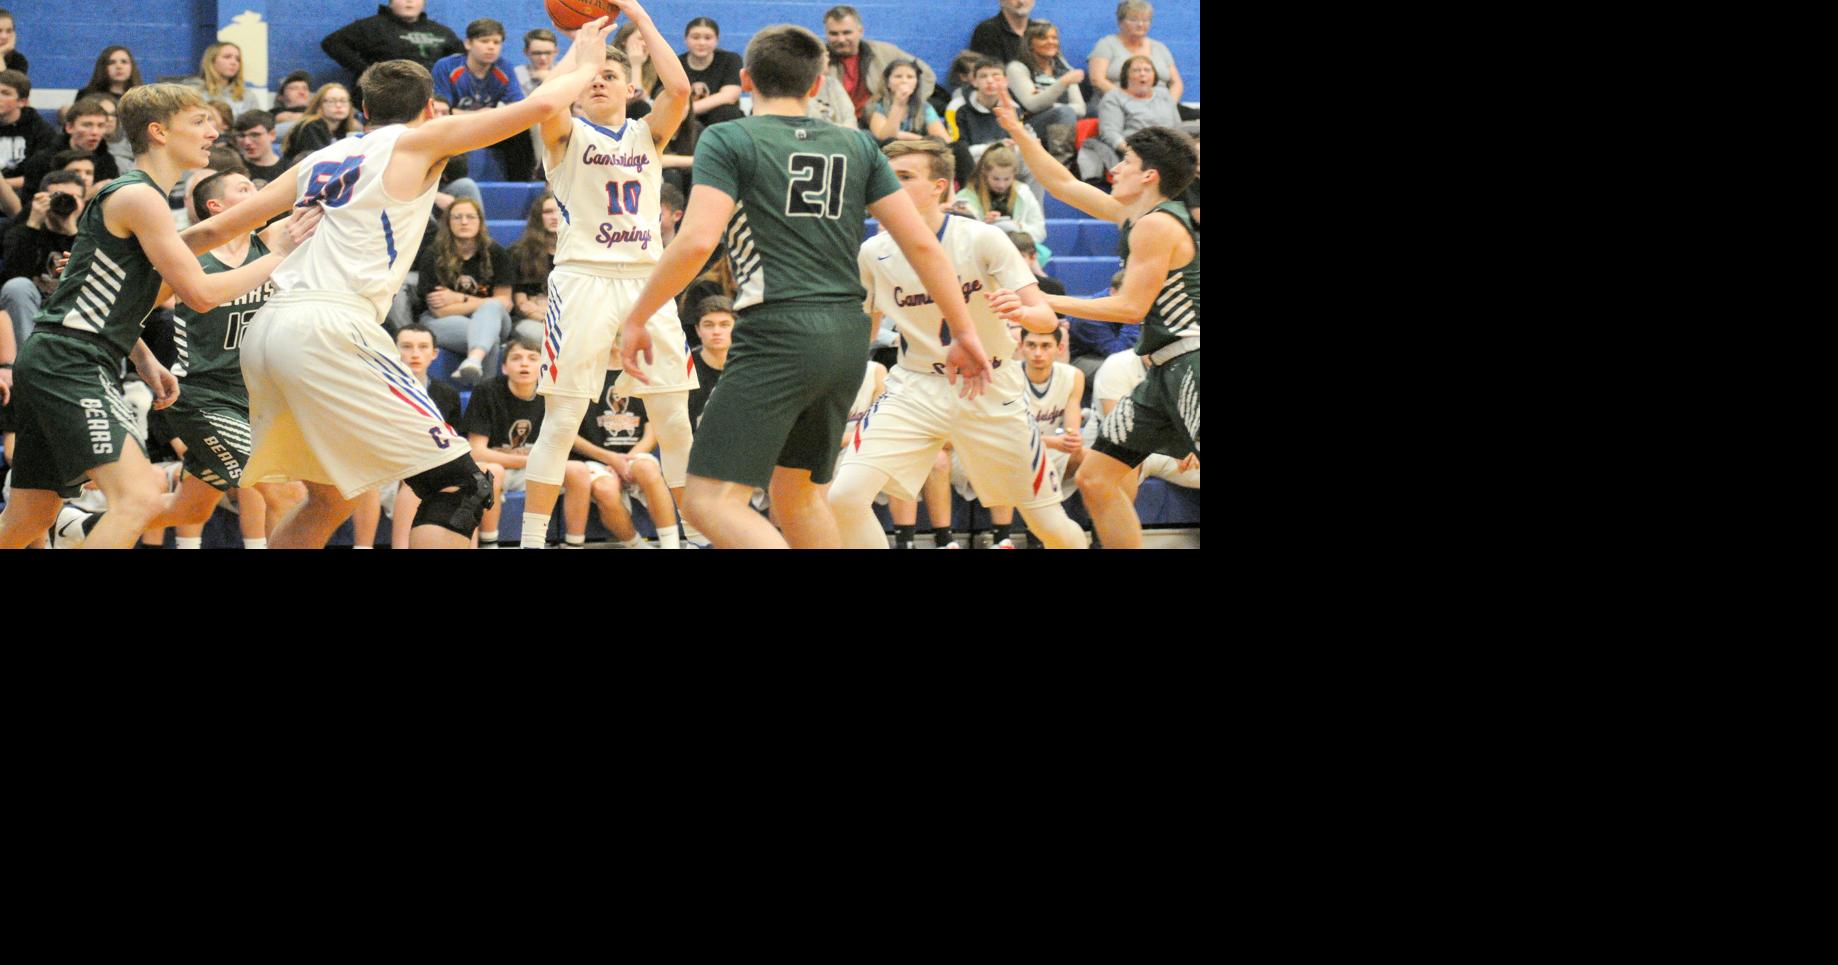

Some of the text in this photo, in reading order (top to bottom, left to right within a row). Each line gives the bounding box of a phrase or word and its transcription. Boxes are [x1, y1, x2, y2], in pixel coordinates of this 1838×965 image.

[605, 180, 642, 215] 10
[785, 152, 847, 219] 21
[80, 398, 113, 455] BEARS
[429, 426, 450, 449] C
[203, 435, 242, 480] BEARS
